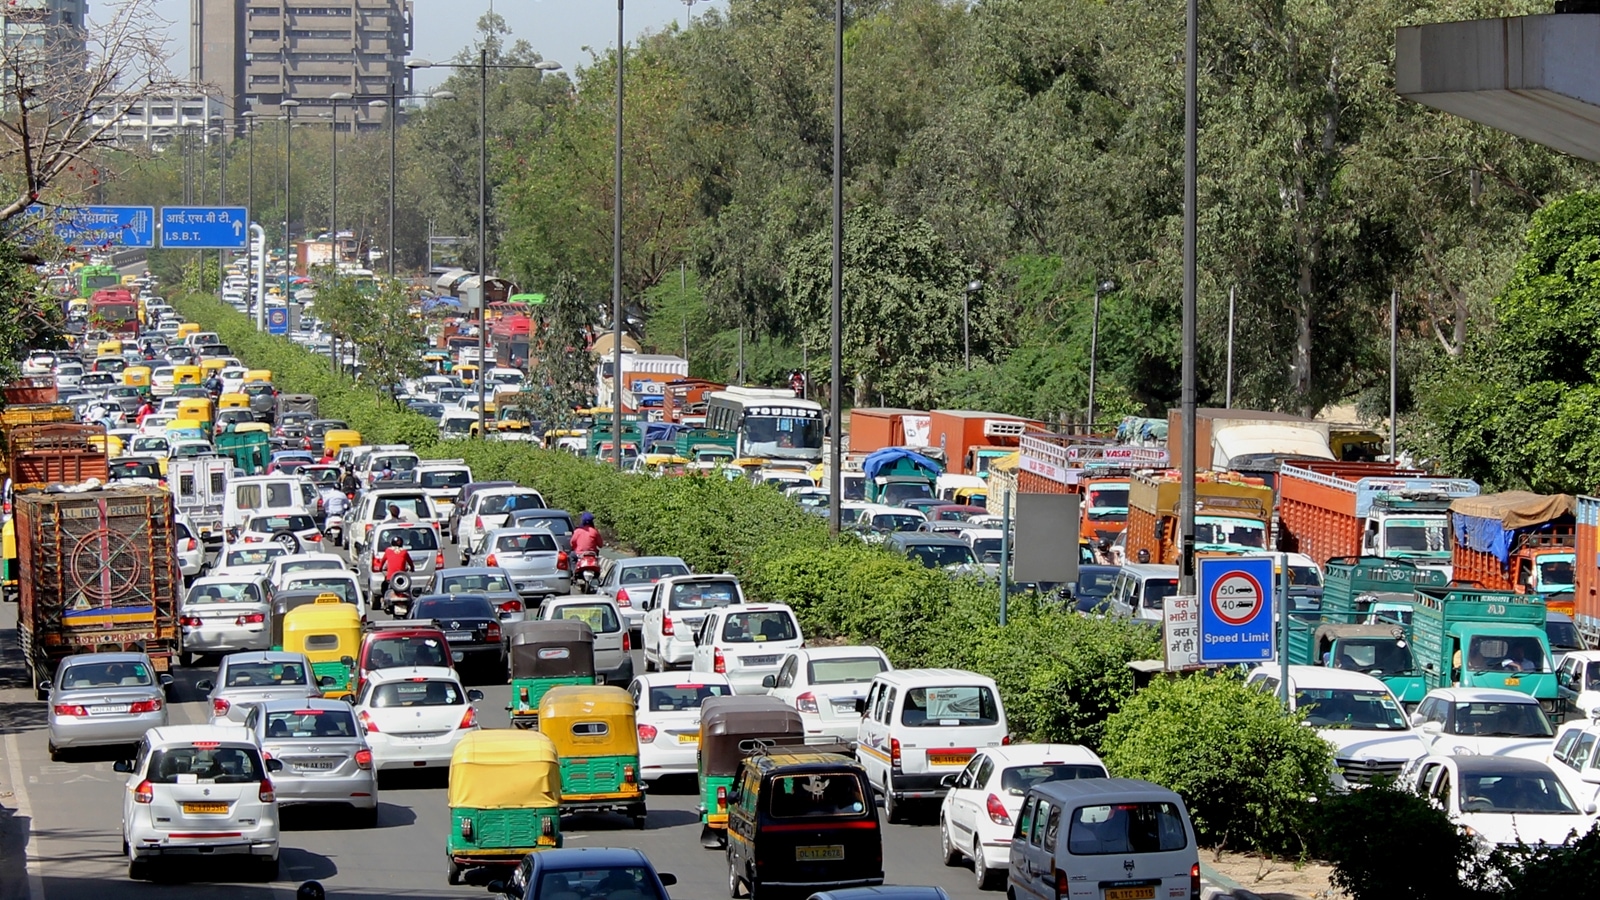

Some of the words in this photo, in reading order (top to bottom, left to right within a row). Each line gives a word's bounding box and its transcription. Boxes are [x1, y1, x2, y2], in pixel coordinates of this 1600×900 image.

[165, 231, 201, 241] I.S.B.T.
[749, 407, 818, 418] TOURIST
[110, 504, 148, 515] PERMIT
[1221, 600, 1235, 610] 40
[1204, 632, 1238, 645] Speed
[1241, 632, 1270, 642] Limit
